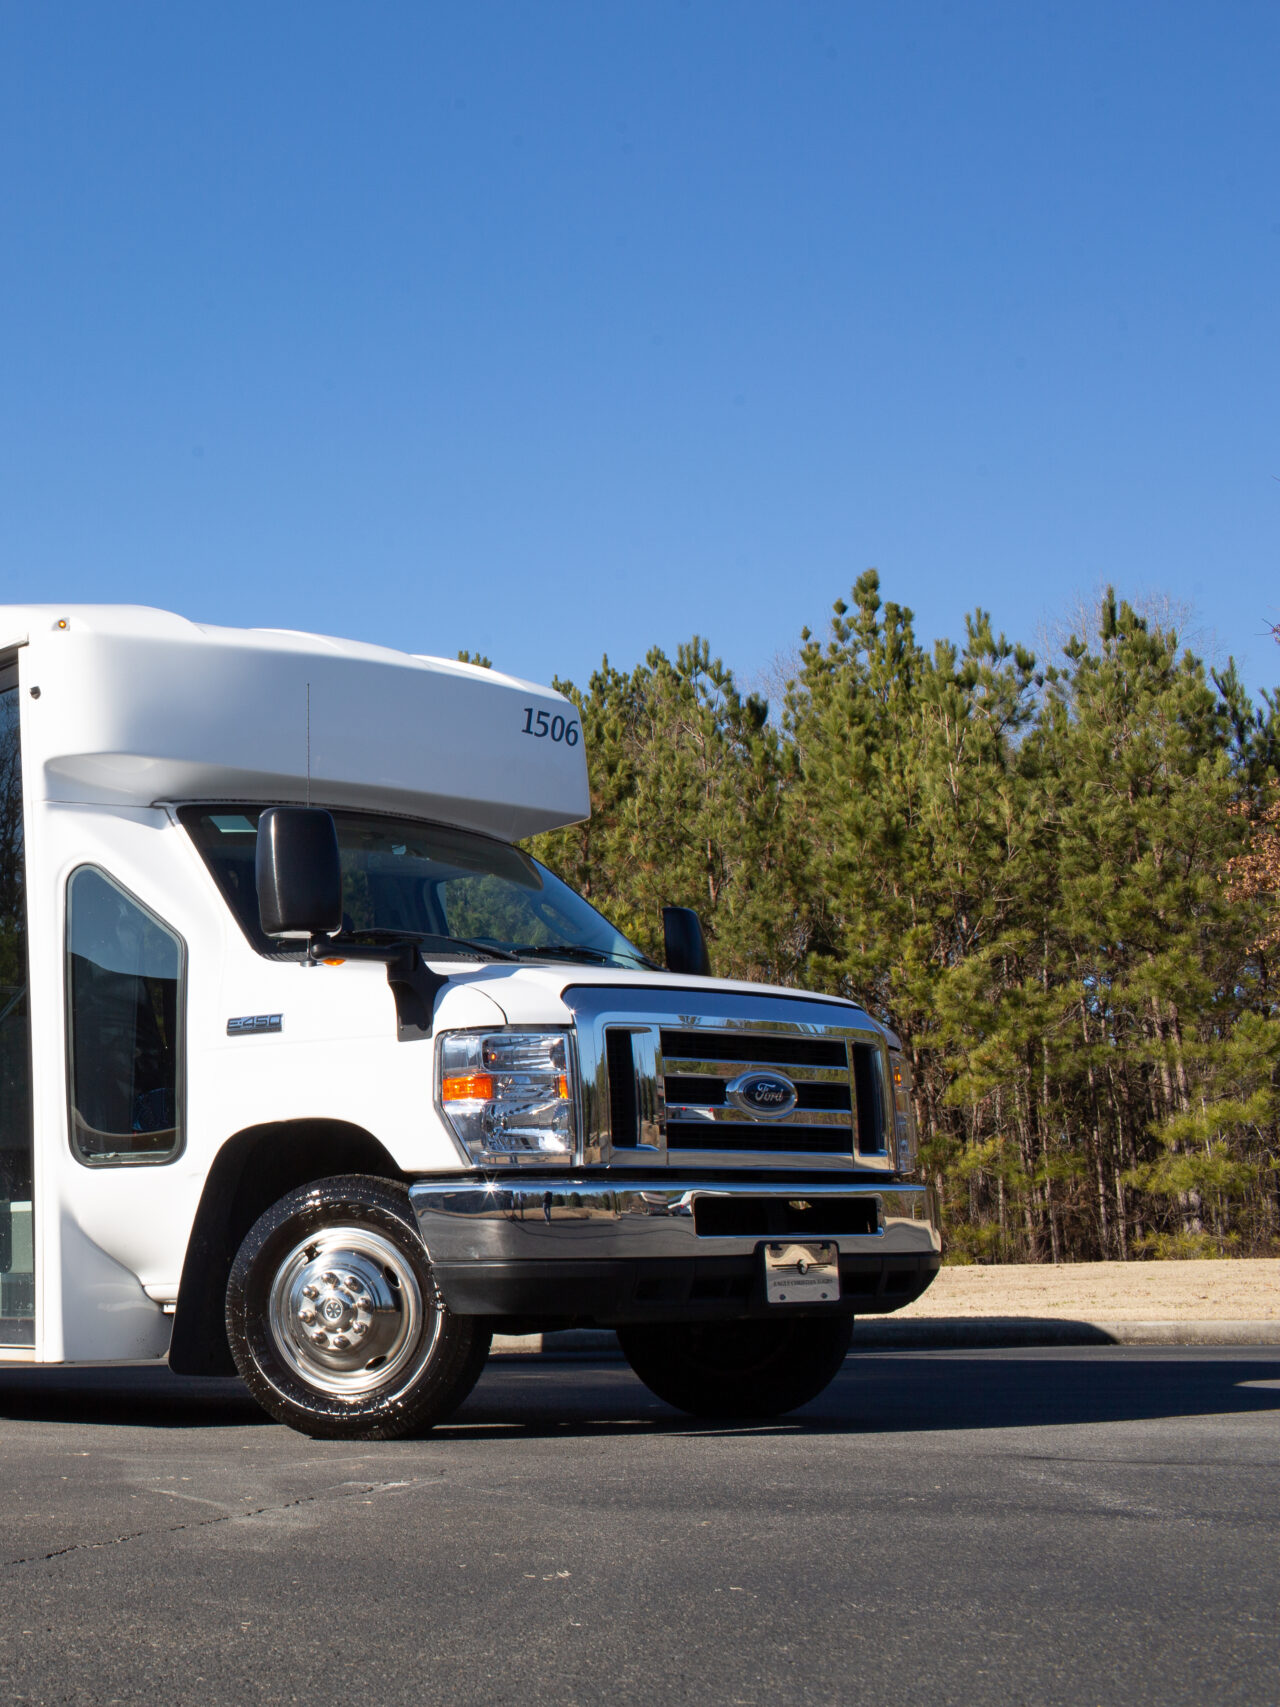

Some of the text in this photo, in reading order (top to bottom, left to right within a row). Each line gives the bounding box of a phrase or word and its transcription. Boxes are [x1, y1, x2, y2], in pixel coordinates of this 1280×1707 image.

[521, 707, 579, 747] 1506
[227, 1014, 282, 1029] E-450
[754, 1082, 785, 1102] Ford
